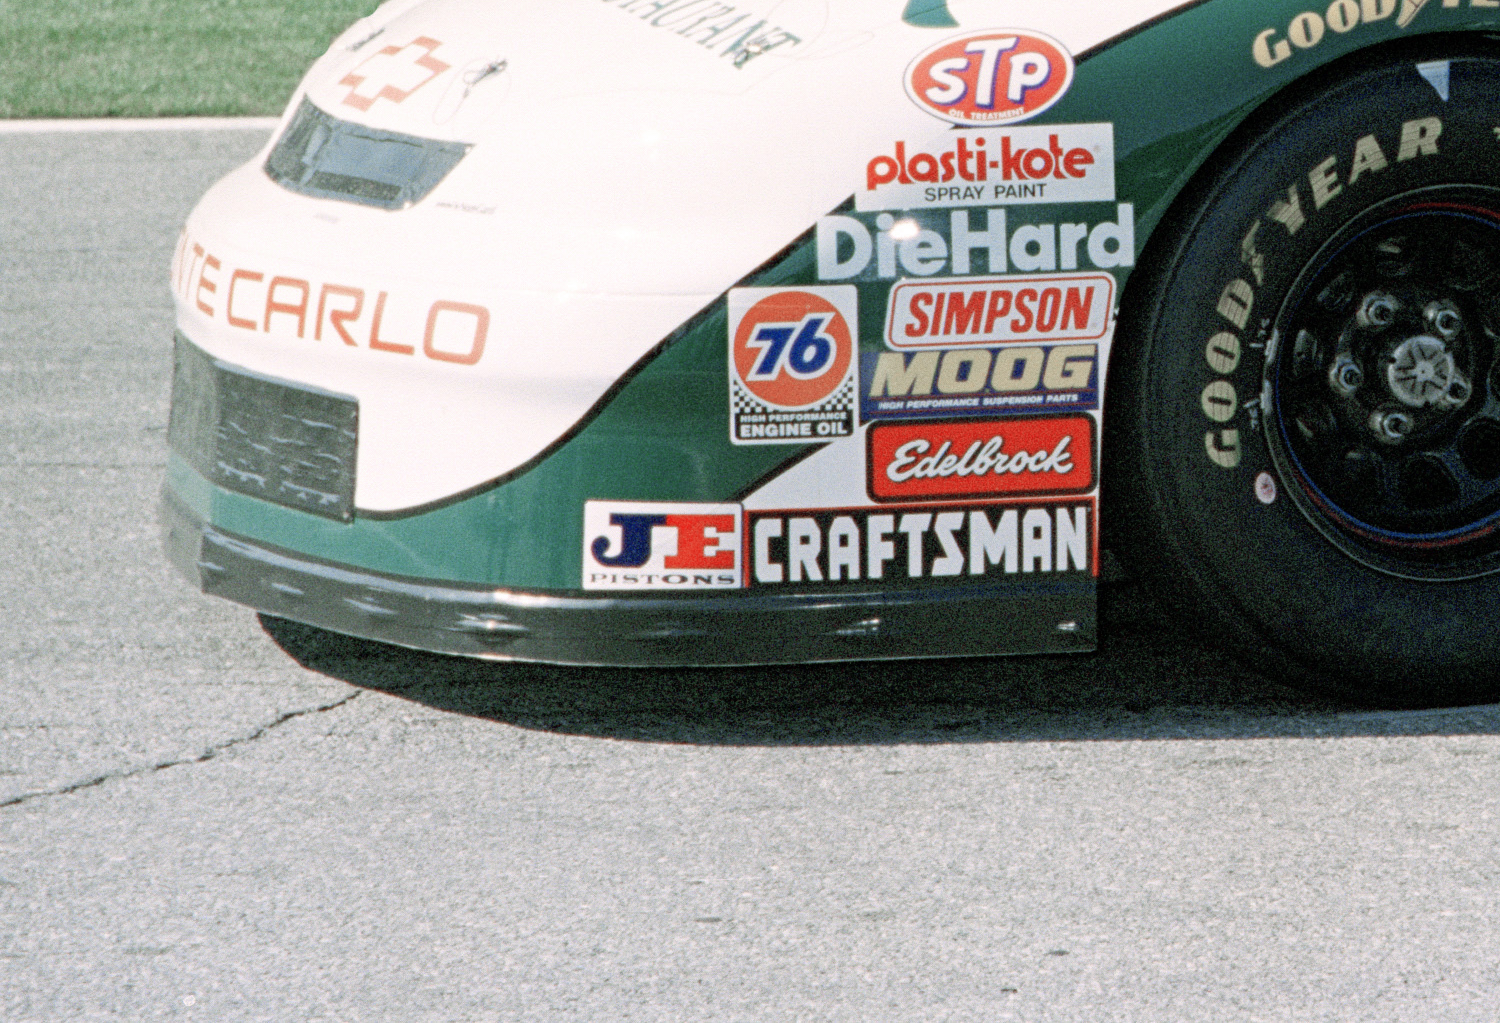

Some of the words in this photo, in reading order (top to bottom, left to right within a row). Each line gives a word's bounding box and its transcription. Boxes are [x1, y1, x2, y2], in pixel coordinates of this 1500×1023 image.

[925, 36, 1052, 110] STP
[949, 109, 966, 120] OIL
[970, 107, 1025, 121] TREATMENT
[866, 133, 1095, 191] plasti-kote
[925, 185, 985, 202] SPRAY
[995, 183, 1048, 199] PAINT
[816, 202, 1135, 280] DieHard
[226, 267, 491, 367] CARLO
[905, 286, 1095, 338] SIMPSON
[746, 312, 837, 381] 76
[869, 344, 1097, 397] MOOG
[740, 414, 766, 423] HIGH
[768, 411, 847, 422] PERFORMANCE
[878, 400, 904, 410] HIGH
[906, 397, 980, 410] PERFORMANCE
[983, 395, 1044, 406] SUSPENSION
[1046, 393, 1079, 404] PARTS
[740, 422, 812, 438] ENGINE
[817, 421, 848, 435] OIL
[886, 434, 1074, 484] Edelbrock
[591, 512, 735, 569] JE
[754, 507, 1090, 582] CRAFTSMAN
[590, 573, 736, 585] PISTONS
